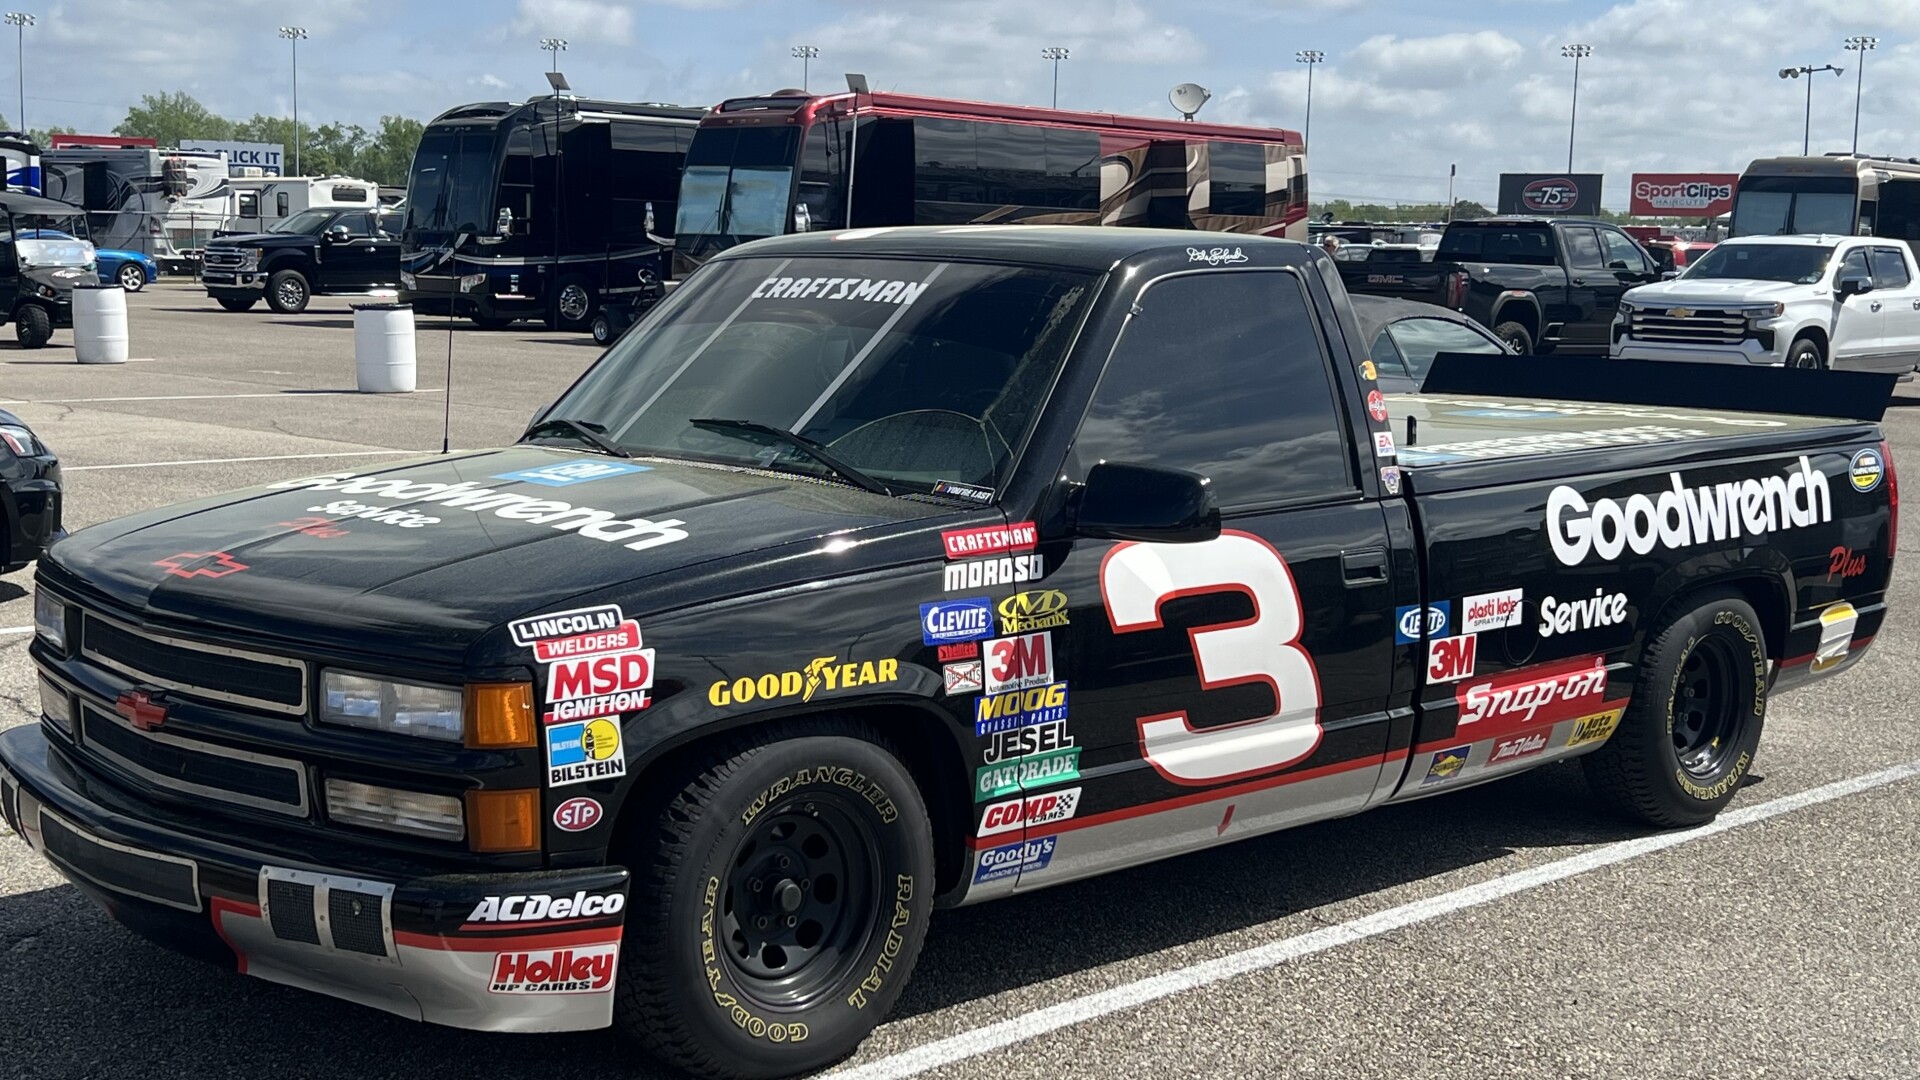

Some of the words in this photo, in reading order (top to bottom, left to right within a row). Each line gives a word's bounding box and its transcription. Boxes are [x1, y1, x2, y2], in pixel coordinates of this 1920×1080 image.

[266, 152, 280, 164] IT
[751, 277, 929, 305] CRAFTSMAN
[1368, 275, 1403, 283] GMC
[1379, 435, 1392, 447] EA
[971, 490, 992, 500] LAST
[266, 472, 689, 551] Goodwrench
[307, 500, 441, 528] Service
[1546, 456, 1832, 566] Goodwrench
[948, 526, 1033, 552] CRAFTSMAN
[944, 554, 1043, 591] MOROSO
[1827, 546, 1867, 583] Plus
[519, 612, 615, 639] LINCOLN
[927, 606, 987, 633] CLEVITE
[1000, 609, 1070, 635] Mechanix
[1468, 599, 1495, 622] plasti
[1474, 618, 1495, 627] SPRAY
[1539, 588, 1627, 638] Service
[548, 633, 629, 656] WELDERS
[992, 634, 1046, 682] 3M
[1098, 528, 1324, 786] 3
[1430, 636, 1475, 680] 3M
[553, 654, 649, 700] MSD
[1714, 611, 1765, 716] GOODYEAR
[709, 658, 898, 706] GOODYEAR
[989, 681, 1022, 693] Automotive
[1024, 676, 1052, 687] Products
[1458, 669, 1605, 725] Snap-on
[552, 690, 645, 721] IGNITION
[977, 684, 1067, 722] MOOG
[981, 715, 1024, 735] CHASSIS
[1031, 708, 1064, 723] PARTS
[1580, 726, 1612, 741] Meter
[1586, 716, 1611, 730] Auto
[986, 721, 1073, 764] JESEL
[552, 759, 623, 784] BILSTEIN
[980, 754, 1075, 792] GATORADE
[1676, 751, 1749, 800] WRANGLER
[742, 766, 898, 825] WRANGLER
[560, 802, 594, 825] STP
[985, 796, 1057, 829] COMP
[1032, 810, 1065, 824] CAMS
[981, 839, 1054, 870] Goody's
[466, 891, 625, 922] ACDelco
[848, 874, 913, 1009] RADIAL
[496, 951, 614, 989] Holley
[702, 876, 808, 1042] GOODYEAR
[525, 981, 590, 991] CARBS
